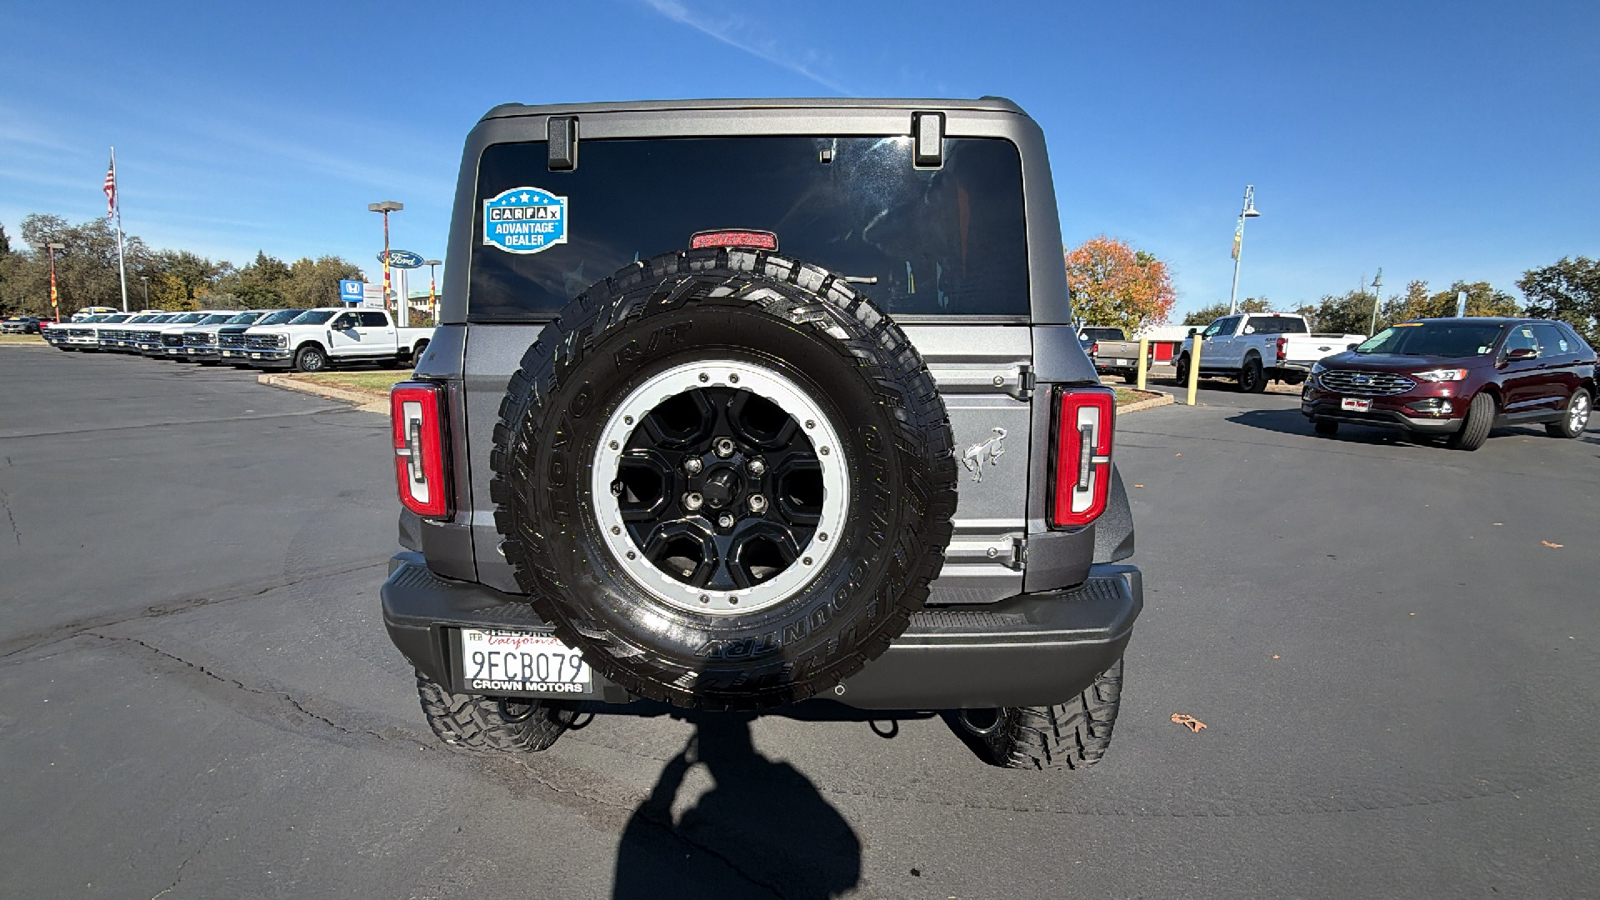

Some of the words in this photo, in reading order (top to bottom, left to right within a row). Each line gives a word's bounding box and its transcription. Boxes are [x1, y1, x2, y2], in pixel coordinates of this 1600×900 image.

[490, 206, 558, 221] CARFAX
[495, 222, 555, 234] ADVANTAGE
[505, 235, 544, 246] DEALER
[390, 252, 416, 266] Ford
[469, 633, 483, 641] FEB
[472, 651, 583, 682] 9FCB079
[472, 679, 523, 691] CROWN
[525, 682, 583, 693] MOTORS
